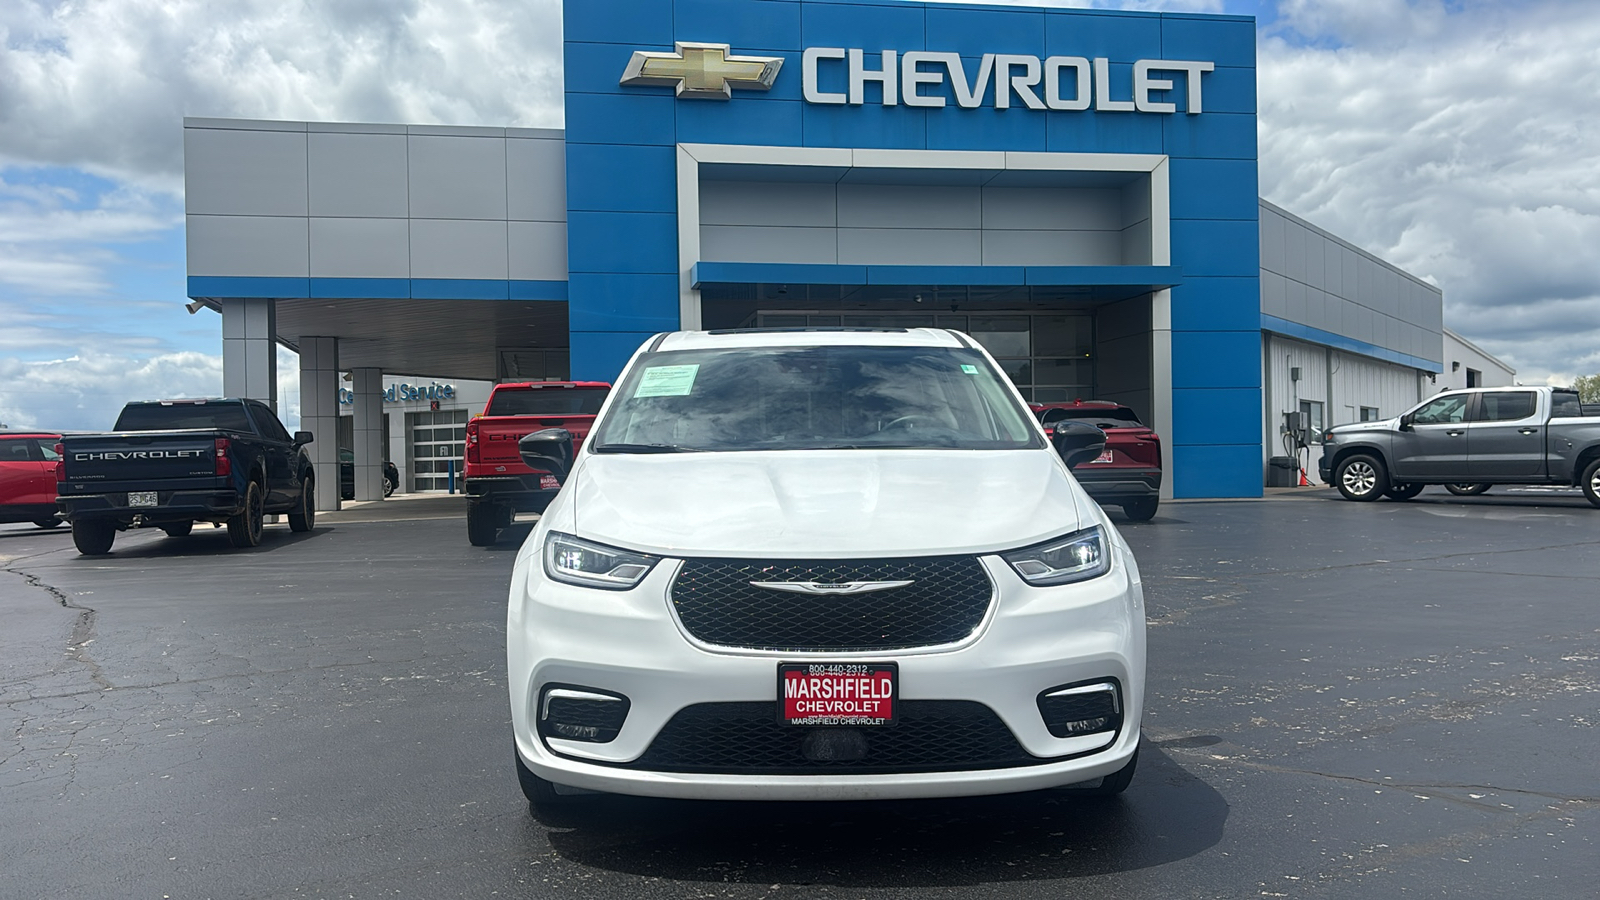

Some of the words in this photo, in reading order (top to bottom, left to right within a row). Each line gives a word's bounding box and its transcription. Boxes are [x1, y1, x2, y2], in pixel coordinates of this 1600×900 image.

[802, 47, 1215, 115] CHEVROLET
[400, 381, 454, 400] Service
[75, 450, 204, 461] CHEVROLET
[808, 664, 868, 673] 800-440-2312
[785, 678, 893, 699] MARSHFIELD
[796, 701, 881, 712] CHEVROLET
